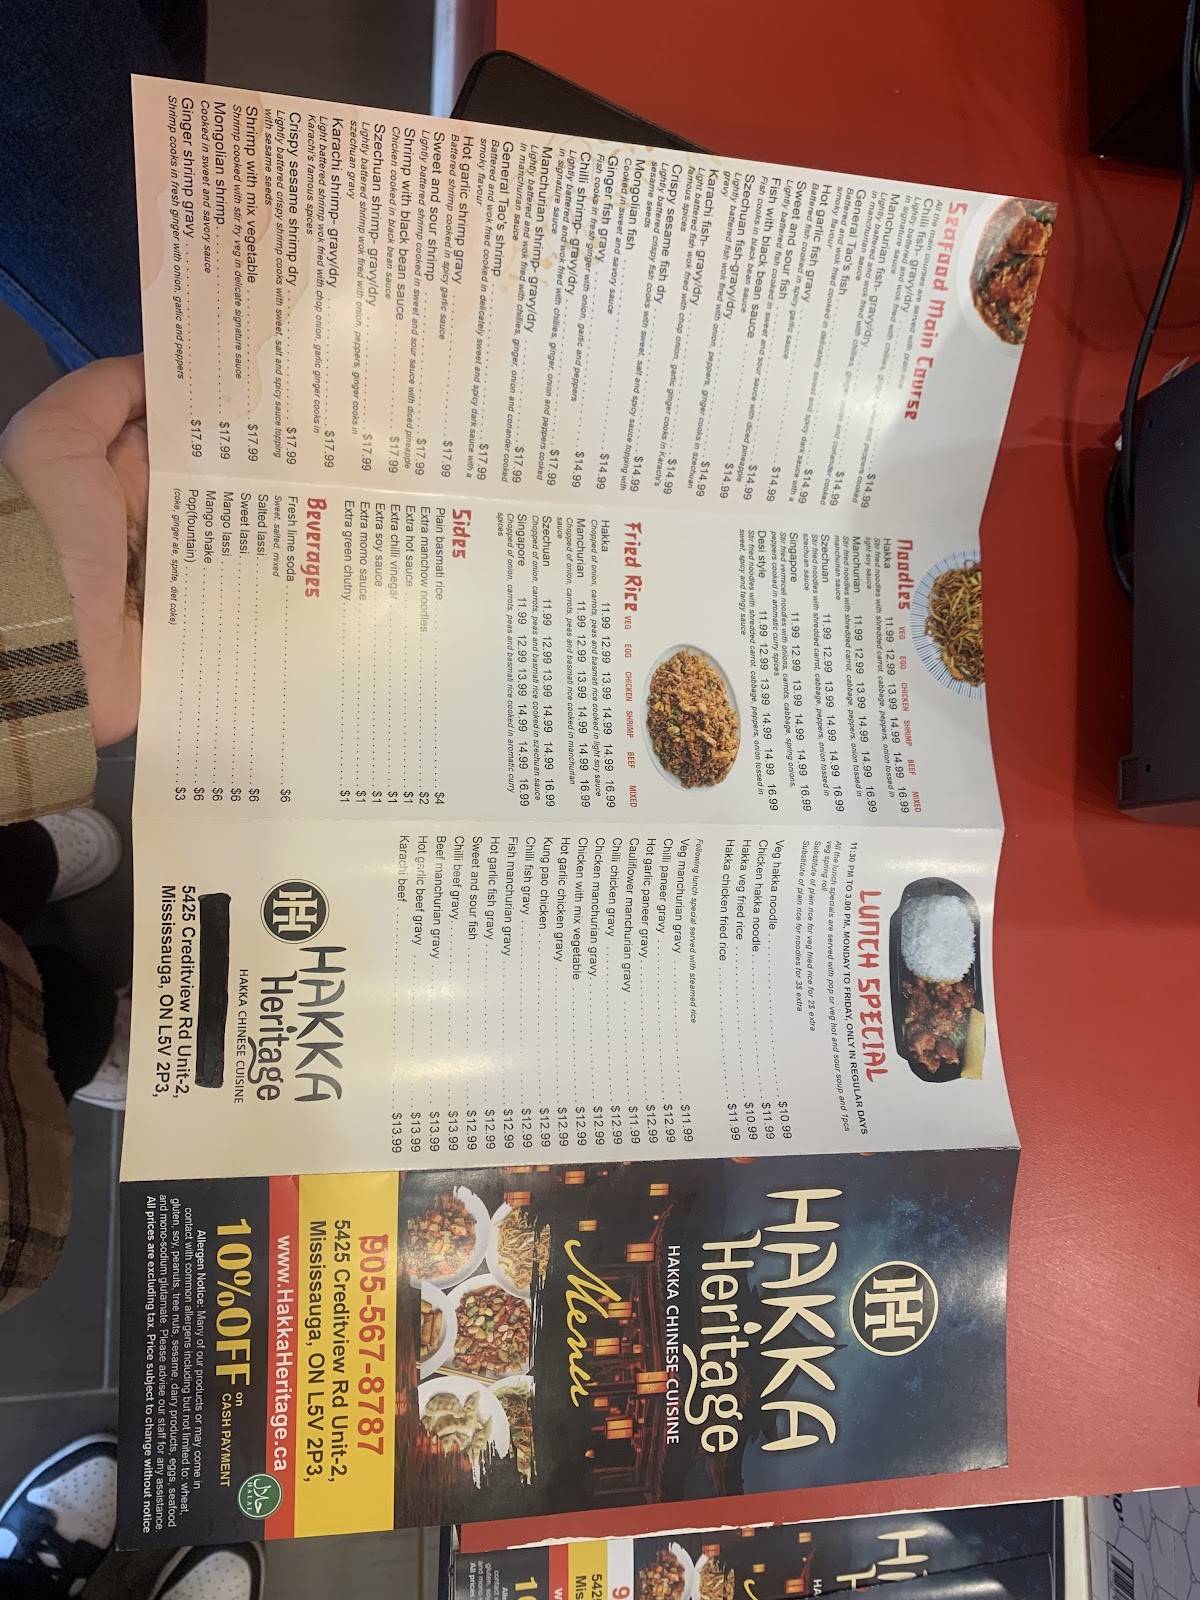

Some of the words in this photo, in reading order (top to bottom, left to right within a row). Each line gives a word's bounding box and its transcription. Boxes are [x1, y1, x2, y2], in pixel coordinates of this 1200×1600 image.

[180, 97, 194, 147] Ginger
[231, 104, 242, 142] Shrimp
[244, 105, 258, 156] Shrimp
[331, 118, 344, 171] Karachi
[461, 135, 474, 160] Hot
[181, 149, 195, 197] shrimp
[233, 144, 242, 183] cooked
[246, 160, 258, 188] with
[458, 163, 471, 200] garlic
[233, 184, 243, 204] with
[246, 192, 256, 216] mix
[327, 174, 342, 225] shrimp-
[181, 200, 194, 239] gravy
[231, 224, 243, 238] fry
[233, 206, 242, 224] stir
[454, 202, 469, 246] shrimp
[848, 189, 866, 238] General
[232, 240, 241, 258] veg
[234, 259, 241, 269] in
[244, 220, 258, 284] vegetable
[325, 228, 339, 288] gravy/dry
[842, 241, 857, 272] Tao's
[932, 201, 968, 292] Seafood
[451, 249, 464, 285] gravy
[838, 275, 851, 296] fish
[234, 270, 243, 307] delicate
[232, 308, 243, 351] signature
[920, 299, 946, 349] Main
[904, 356, 934, 421] Course
[190, 419, 202, 458] $17.99
[247, 423, 259, 463] $17.99
[323, 430, 335, 468] $17.99
[440, 440, 453, 478] $17.99
[798, 468, 814, 504] $14.99
[183, 489, 199, 563] Pop(fountain)
[287, 496, 298, 527] Fresh
[435, 507, 446, 534] Plain
[286, 529, 298, 552] lime
[300, 497, 328, 598] Beverages
[451, 508, 472, 559] Sides
[624, 522, 642, 568] Fried
[286, 555, 297, 582] soda
[435, 536, 446, 578] basmati
[883, 538, 892, 569] Hakka
[435, 581, 446, 601] rice
[896, 539, 914, 610] Noodles
[624, 575, 643, 612] Rice
[884, 616, 895, 643] 11.99
[898, 626, 906, 640] VEG
[886, 648, 896, 676] 12.99
[898, 655, 907, 670] EGG
[887, 684, 898, 710] 13.99
[900, 682, 910, 712] CHICKEN
[889, 716, 901, 744] 14.99
[903, 719, 913, 747] SHRIMP
[893, 752, 905, 779] 14.99
[907, 759, 917, 776] BEEF
[174, 786, 187, 801] $3
[279, 788, 292, 803] $6
[434, 791, 445, 805] $4
[897, 786, 910, 814] 16.99
[911, 791, 922, 813] MIXED
[398, 835, 410, 875] Karachi
[539, 837, 553, 864] Kung
[626, 837, 640, 895] Cauliflower
[771, 840, 784, 859] Veg
[848, 842, 858, 863] 11:30
[539, 866, 549, 886] pao
[770, 862, 782, 892] hakka
[845, 879, 854, 892] TO
[847, 865, 855, 878] PM
[181, 885, 196, 922] 5425
[397, 878, 408, 903] beef
[844, 894, 852, 911] 3.00
[538, 889, 550, 930] chicken
[768, 895, 778, 930] noodle
[842, 913, 851, 929] PM,
[156, 885, 176, 989] Mississauga,
[623, 897, 634, 960] manchurian
[857, 890, 882, 969] LUNCH
[842, 931, 850, 970] MONDAY
[179, 926, 196, 1013] Creditview
[238, 969, 249, 1007] HAKKA
[621, 962, 631, 993] gravy
[843, 971, 851, 985] TO
[159, 994, 173, 1020] ON
[843, 986, 853, 1021] FRIDAY,
[157, 1025, 173, 1056] L5V
[178, 1017, 193, 1040] Rd
[236, 1010, 248, 1057] CHINESE
[248, 970, 298, 1100] Heritage
[295, 946, 346, 1102] HAKKA
[846, 1023, 856, 1049] ONLY
[857, 978, 889, 1083] SPECIAL
[172, 1045, 192, 1098] Unit-2,
[848, 1050, 856, 1060] IN
[152, 1062, 171, 1097] 2P3,
[234, 1060, 245, 1104] CUISINE
[850, 1062, 864, 1108] REGULAR
[391, 1112, 403, 1154] $13.99
[538, 1107, 551, 1148] $12.99
[628, 1105, 641, 1144] $11.99
[777, 1101, 793, 1139] $10.99
[856, 1110, 868, 1135] DAYS
[146, 1195, 156, 1209] All
[144, 1211, 157, 1241] prices
[334, 1220, 351, 1263] 5425
[147, 1242, 155, 1260] are
[194, 1229, 207, 1270] Allergen
[144, 1261, 156, 1310] excluding
[195, 1271, 206, 1308] Notice:
[304, 1221, 327, 1346] Mississauga,
[666, 1245, 681, 1300] HAKKA
[215, 1218, 252, 1385] 10%OFF
[760, 1189, 843, 1451] HAKKA
[146, 1312, 156, 1331] tax.
[194, 1310, 206, 1337] Many
[332, 1269, 351, 1374] Creditview
[564, 1240, 622, 1407] Menu
[666, 1304, 679, 1373] CHINESE
[146, 1334, 155, 1361] Price
[195, 1350, 204, 1367] our
[196, 1338, 205, 1349] of
[270, 1235, 294, 1472] www.HakkaHeritage.ca
[358, 1236, 388, 1455] 905-567-8787
[682, 1230, 762, 1453] Heritage
[143, 1363, 155, 1402] subject
[308, 1353, 325, 1384] ON
[193, 1369, 205, 1412] products
[235, 1392, 243, 1406] on
[331, 1380, 349, 1408] Rd
[145, 1404, 154, 1415] to
[194, 1413, 202, 1424] or
[221, 1393, 232, 1427] CASH
[307, 1391, 325, 1431] L5V
[665, 1378, 679, 1445] CUISINE
[142, 1417, 154, 1457] change
[191, 1426, 202, 1448] may
[327, 1415, 349, 1482] Unit-2,
[193, 1450, 202, 1478] come
[220, 1430, 232, 1487] PAYMENT
[303, 1437, 324, 1482] 2P3,
[143, 1458, 154, 1499] without
[193, 1480, 201, 1490] in
[142, 1500, 153, 1534] notice
